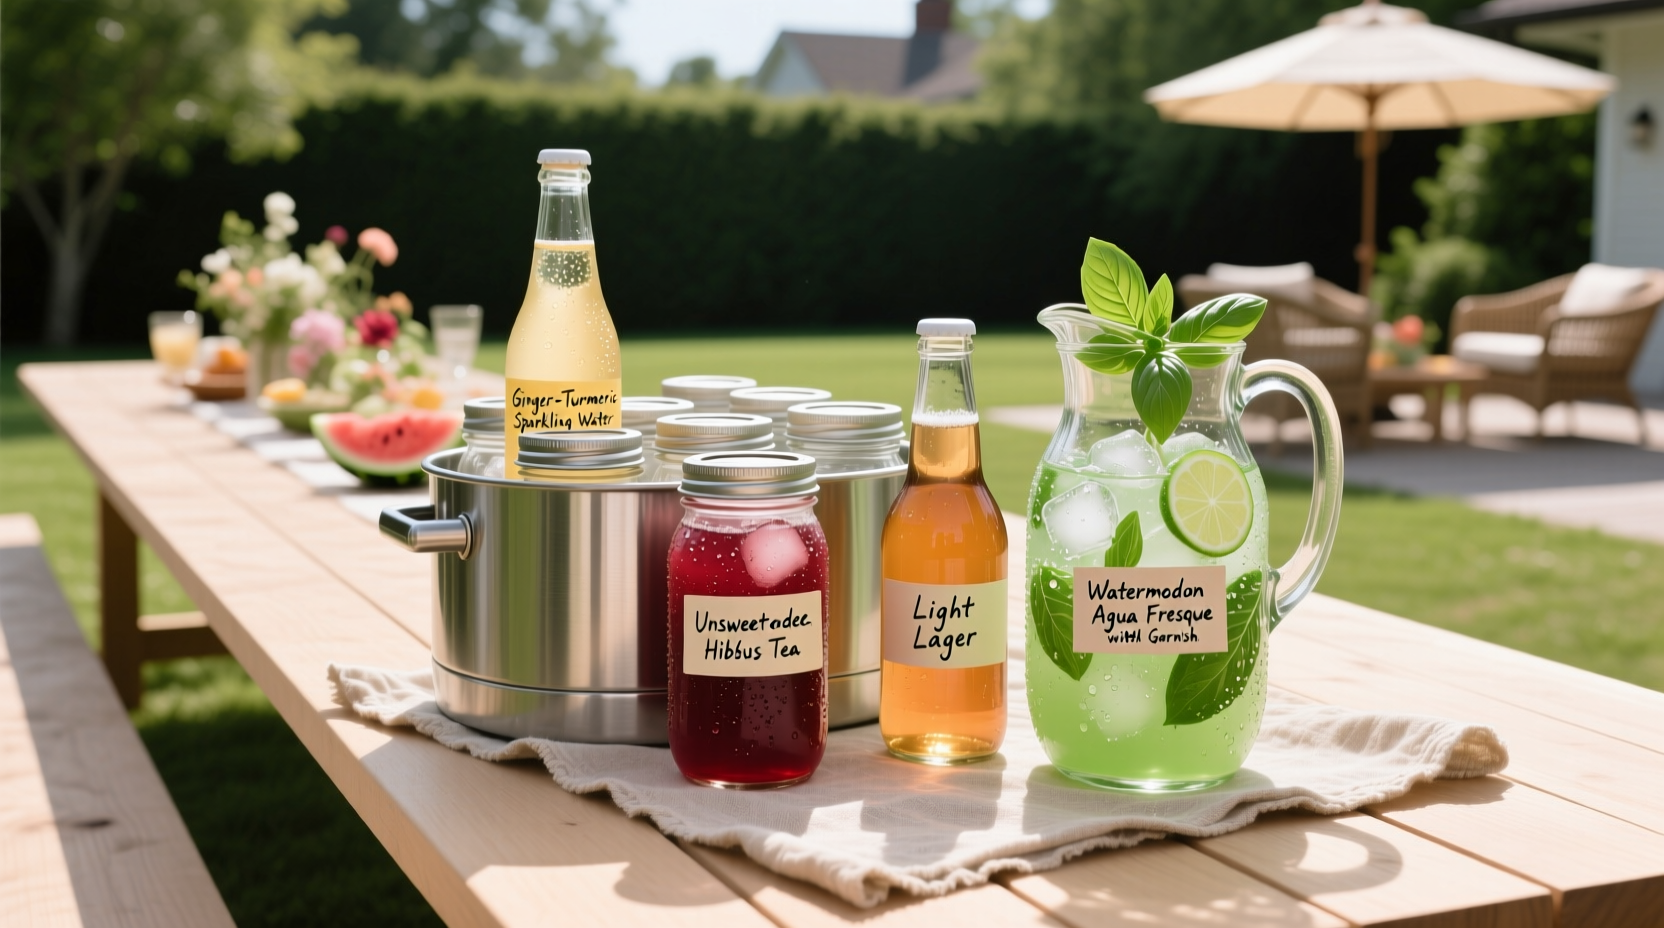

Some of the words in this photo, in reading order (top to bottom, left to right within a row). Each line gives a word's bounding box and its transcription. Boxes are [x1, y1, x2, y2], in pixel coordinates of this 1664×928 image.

[913, 594, 975, 632] Light
[1091, 604, 1138, 633] Agua
[1146, 604, 1213, 626] Fresque
[768, 636, 801, 659] Tea
[913, 624, 977, 661] Lager
